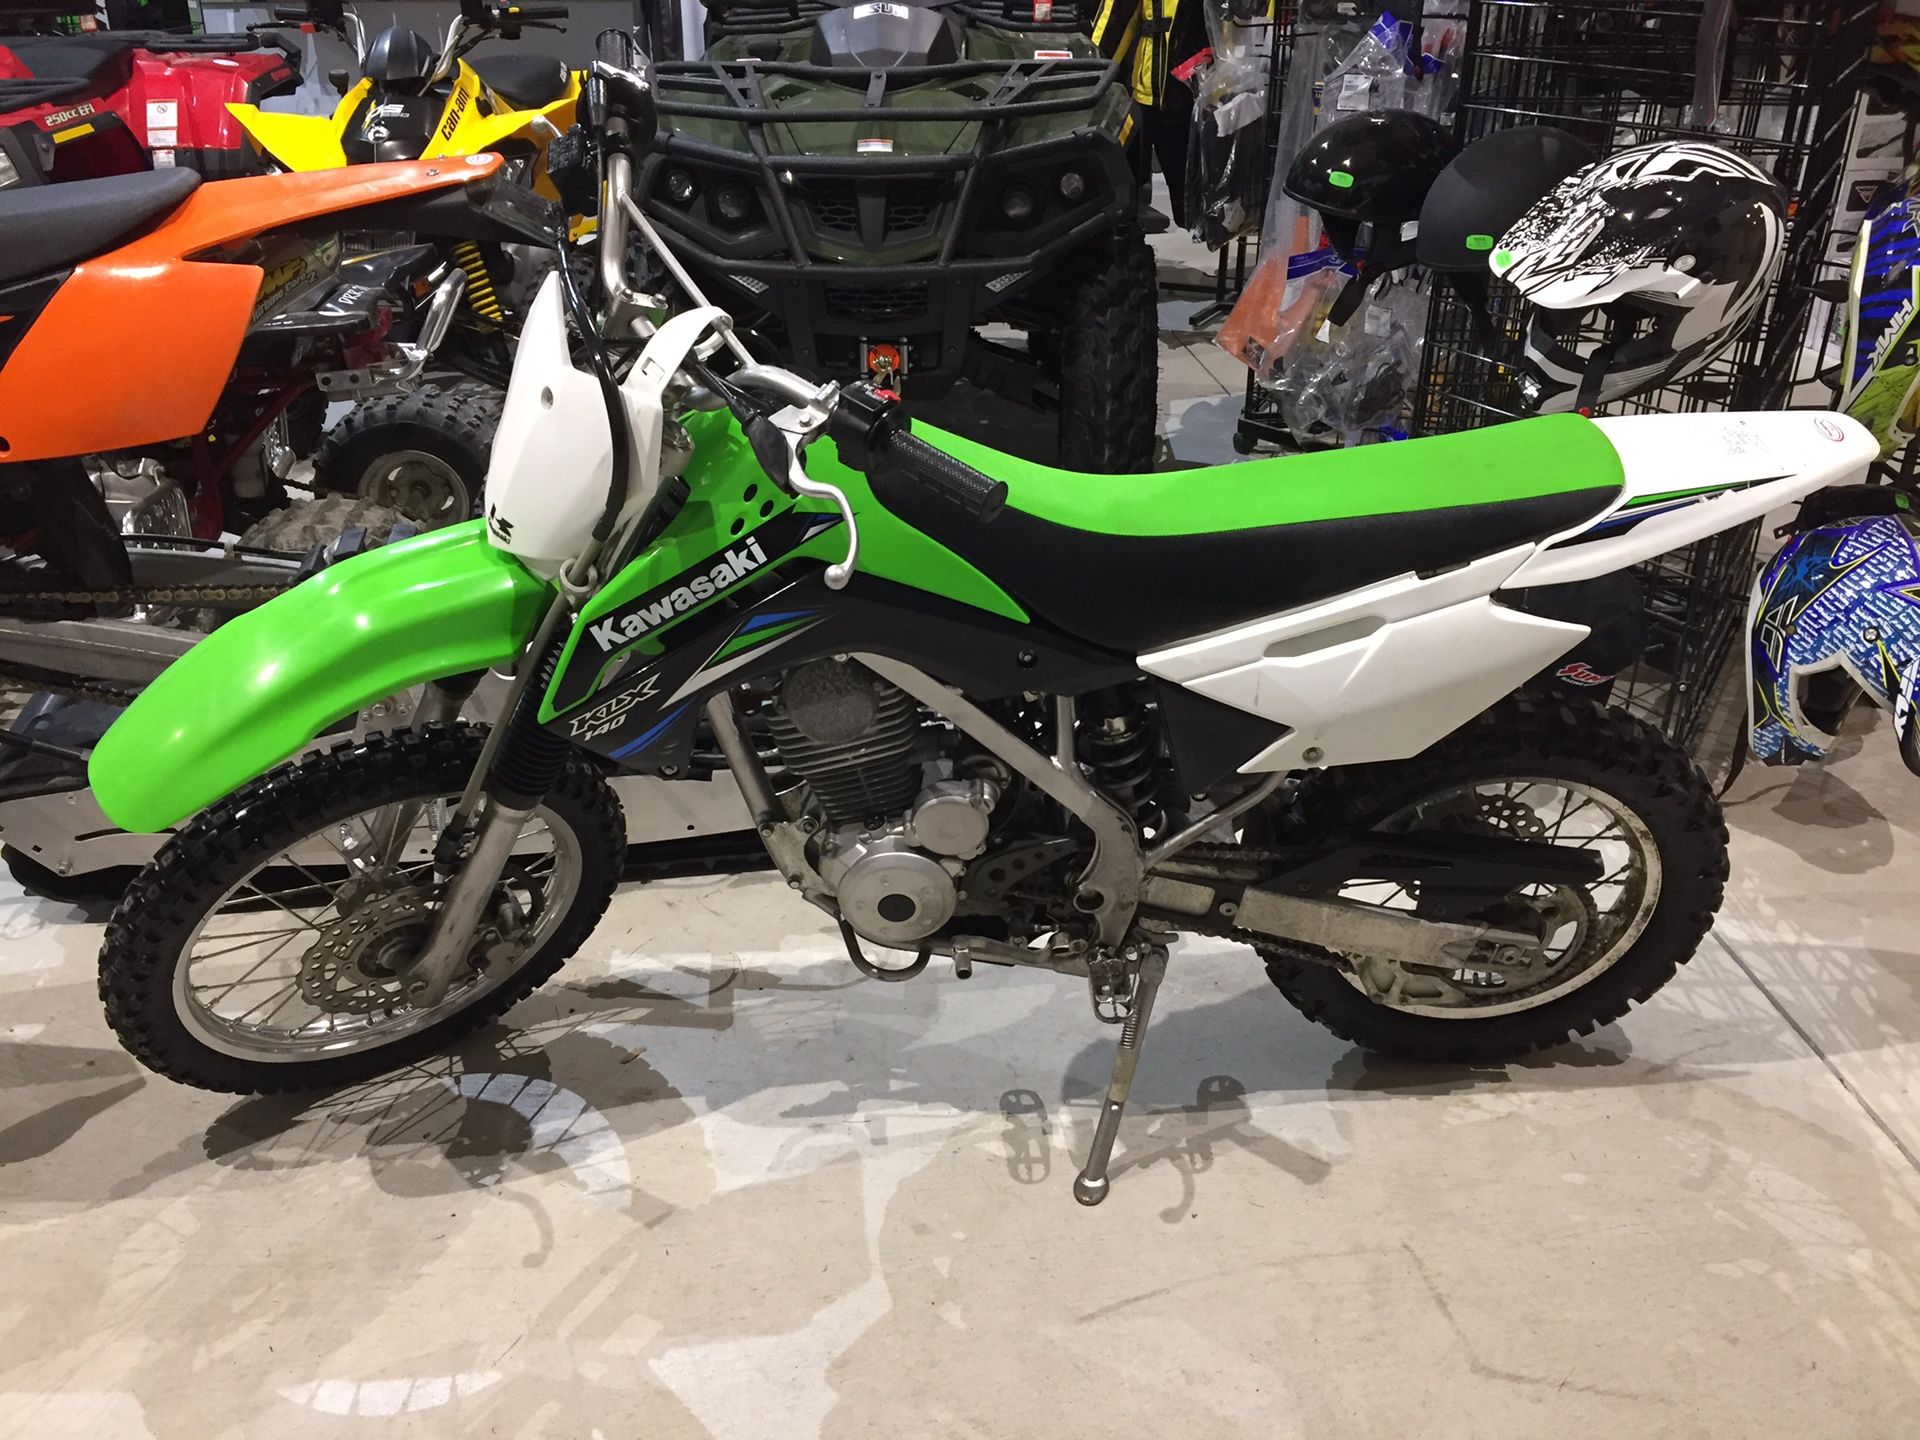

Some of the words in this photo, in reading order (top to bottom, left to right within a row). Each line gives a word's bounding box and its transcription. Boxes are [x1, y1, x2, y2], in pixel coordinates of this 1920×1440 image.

[44, 110, 80, 127] 250cc
[77, 103, 96, 117] EFI
[589, 535, 768, 652] Kawasaki
[568, 672, 662, 737] KLX
[584, 714, 627, 742] 140
